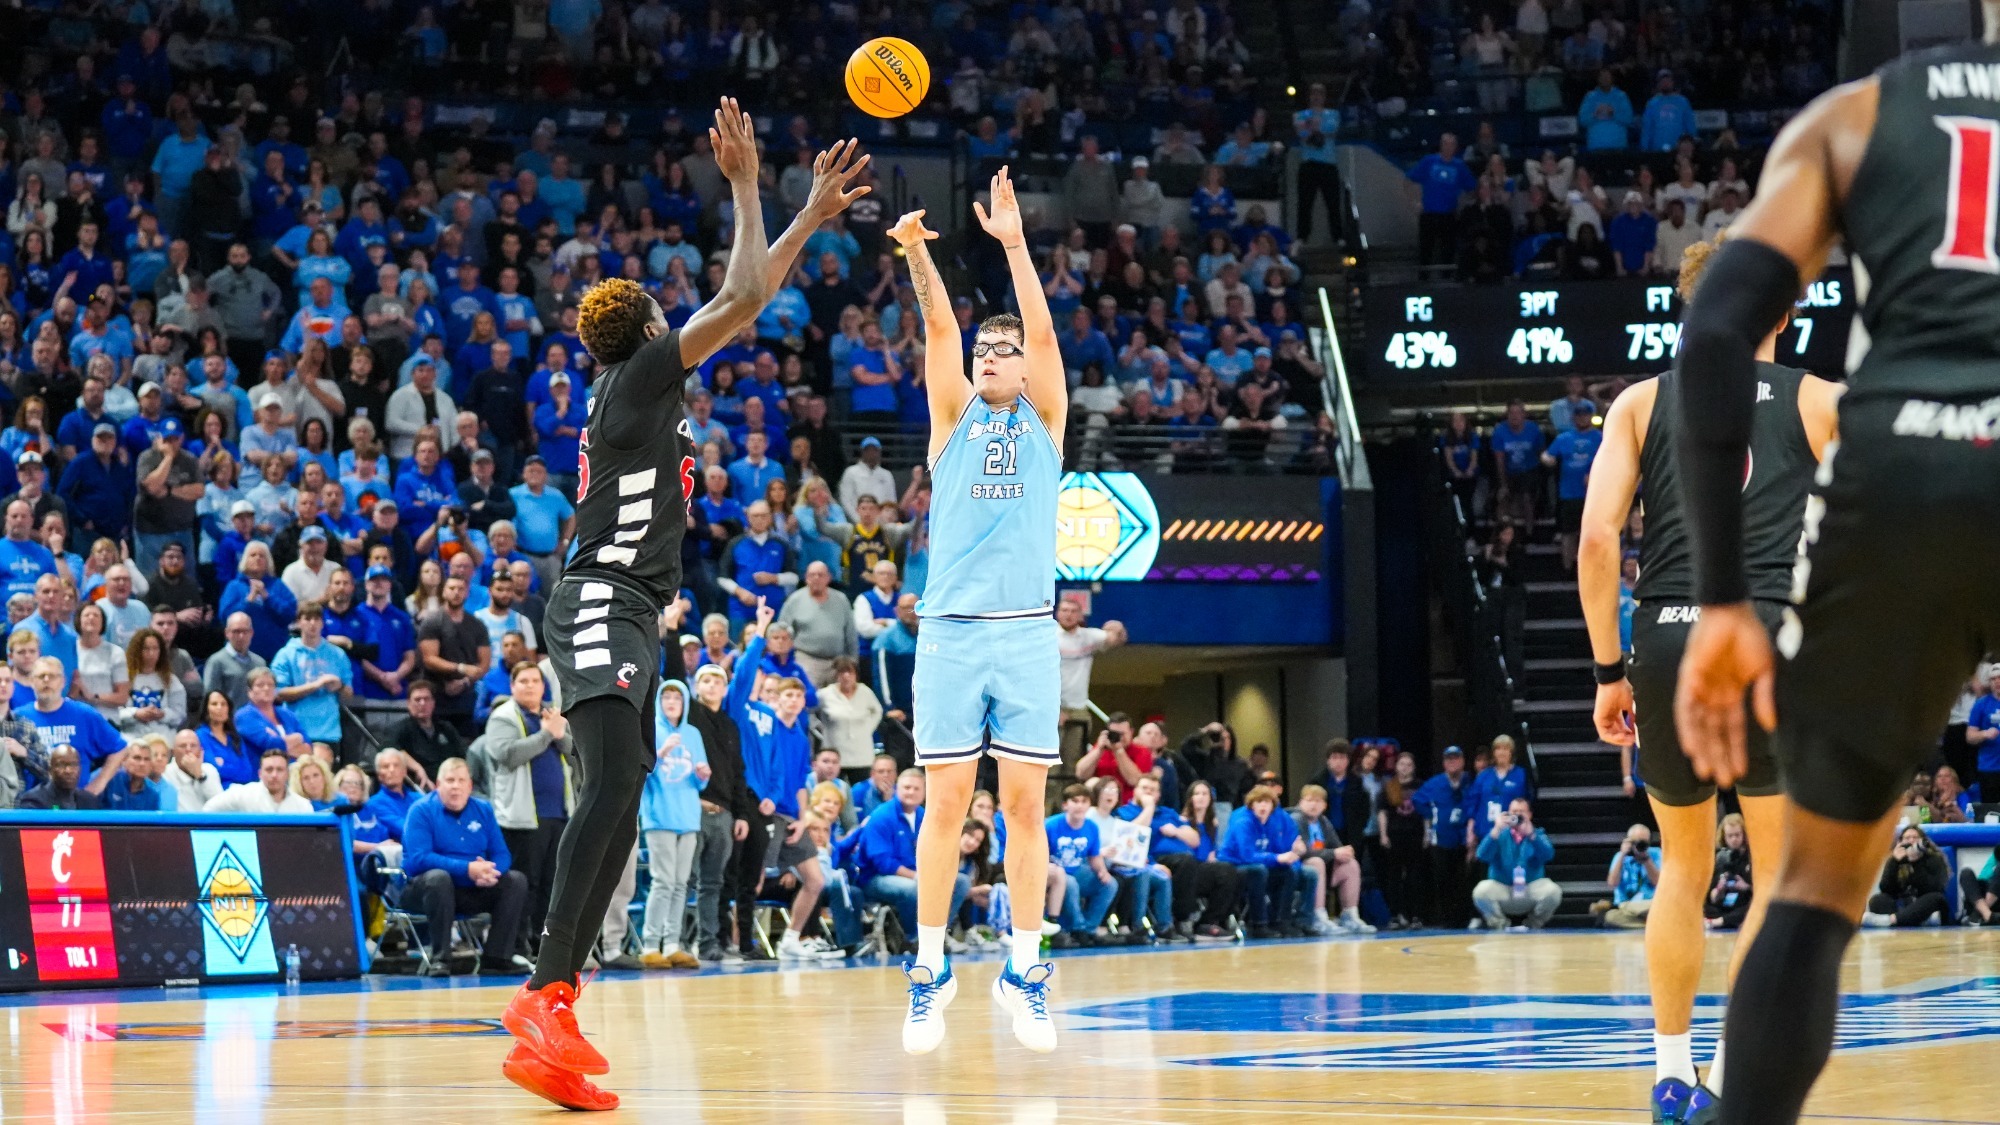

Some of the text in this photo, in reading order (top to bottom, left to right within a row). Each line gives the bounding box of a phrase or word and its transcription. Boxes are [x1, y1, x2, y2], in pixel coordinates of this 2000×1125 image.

[875, 45, 913, 91] Wilson
[1931, 114, 2000, 274] 1
[1519, 291, 1559, 317] 3PT
[1647, 287, 1673, 312] FT
[1794, 281, 1842, 308] ALS
[1406, 297, 1433, 322] FG
[1507, 327, 1573, 364] 41%
[1793, 318, 1813, 354] 7
[1385, 331, 1456, 369] 43%
[1756, 381, 1775, 403] JR.
[984, 441, 1017, 475] 21
[971, 483, 1024, 499] STATE
[1056, 517, 1115, 538] NIT
[58, 895, 82, 928] 77
[214, 894, 251, 912] NIT
[65, 946, 98, 968] TOL 1
